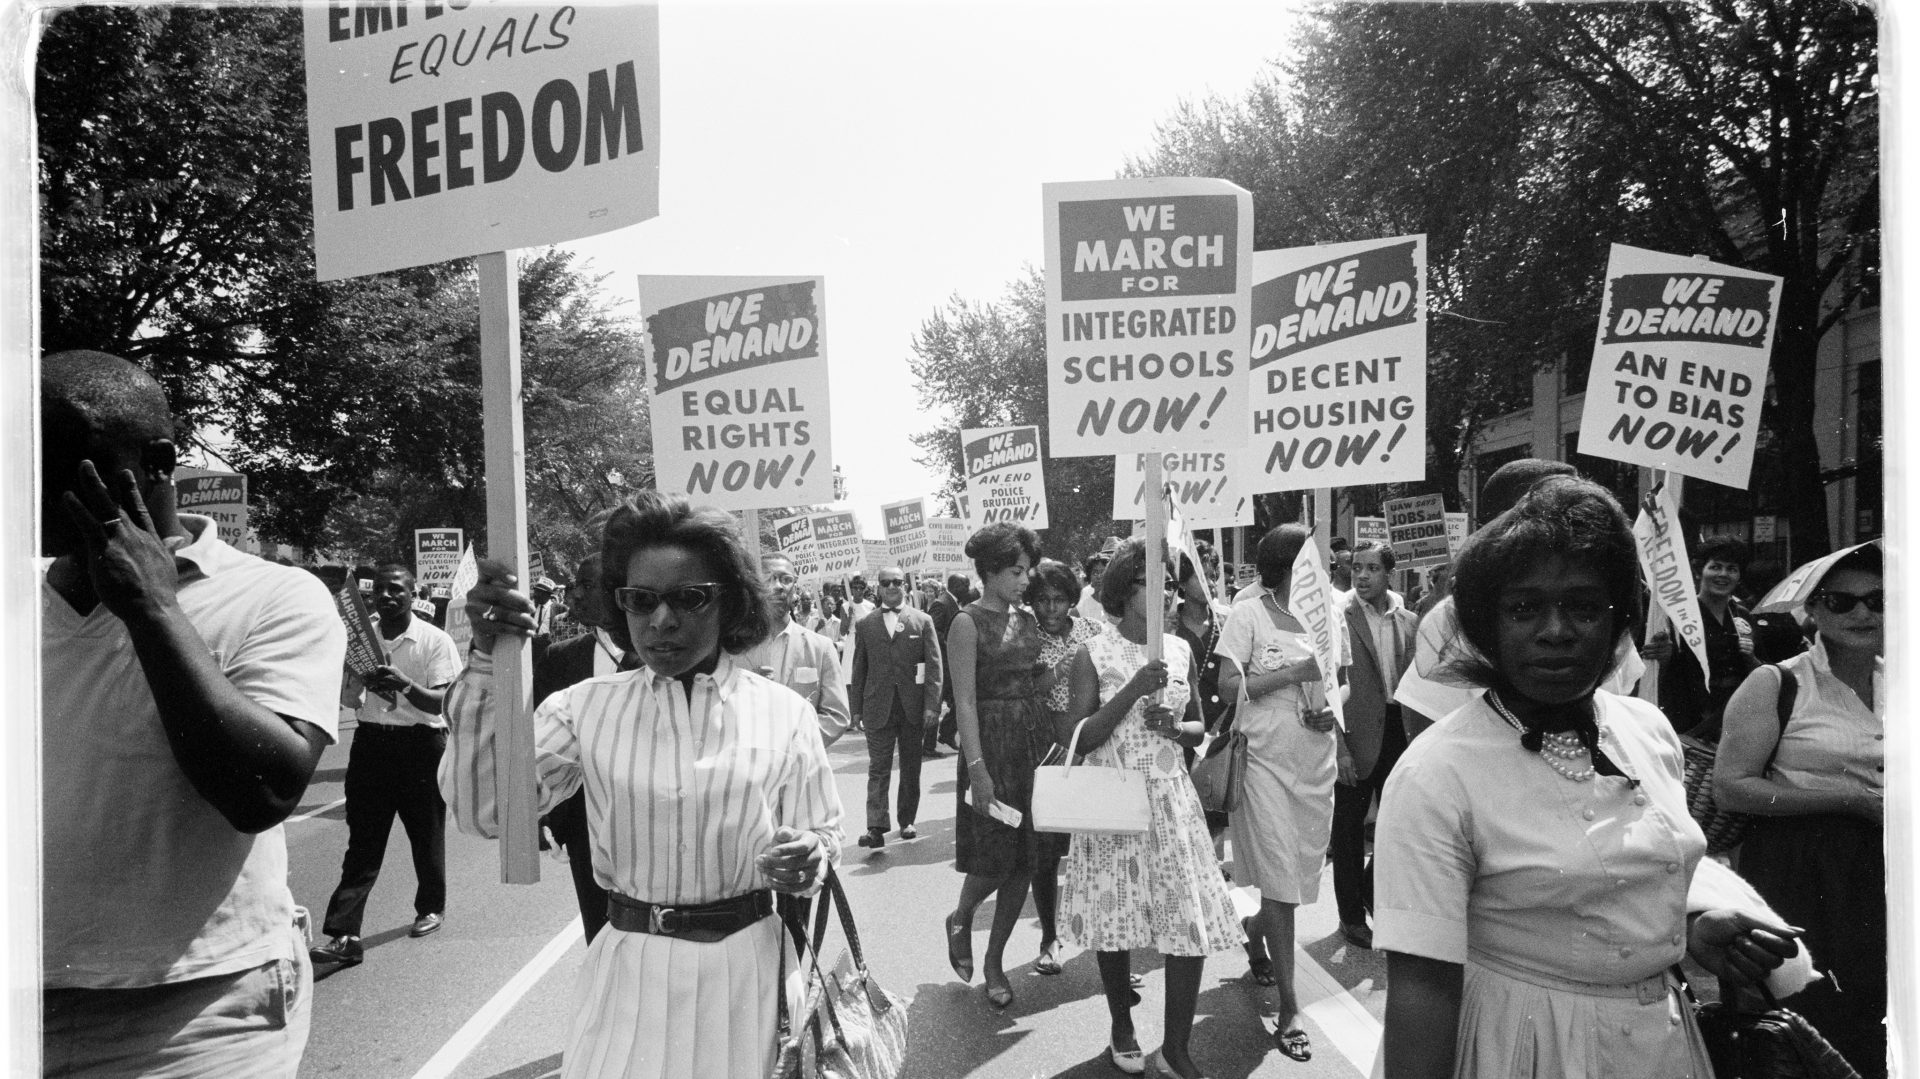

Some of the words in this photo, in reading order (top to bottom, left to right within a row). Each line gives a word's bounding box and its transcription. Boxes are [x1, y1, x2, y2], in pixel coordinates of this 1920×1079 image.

[390, 6, 576, 84] EQUALS
[335, 60, 644, 212] FREEDOM
[1122, 204, 1176, 232] WE
[1074, 234, 1224, 273] MARCH
[1121, 275, 1180, 292] FOR
[1295, 259, 1360, 307] WE
[1662, 277, 1725, 305] WE
[705, 292, 764, 334] WE
[1062, 305, 1237, 342] INTEGRATED
[1251, 281, 1412, 360] DEMAND
[1614, 306, 1764, 338] DEMAND
[665, 317, 813, 381] DEMAND
[1063, 349, 1235, 385] SCHOOLS
[1267, 356, 1402, 394] DECENT
[1615, 350, 1667, 380] AN
[1679, 361, 1752, 397] END
[682, 387, 805, 417] EQUAL
[1076, 386, 1228, 438] NOW!
[1615, 380, 1658, 409] TO
[1668, 390, 1745, 429] BIAS
[1254, 395, 1415, 435] HOUSING
[682, 420, 811, 451] RIGHTS
[988, 432, 1015, 452] WE
[1608, 413, 1742, 464] NOW!
[972, 442, 1034, 474] DEMAND
[1265, 423, 1407, 474] NOW!
[686, 449, 816, 495] NOW!
[1136, 453, 1226, 472] RGHTS
[197, 477, 222, 490] WE
[979, 475, 1000, 485] AN
[1004, 473, 1032, 483] END
[181, 488, 241, 505] DEMAND
[982, 496, 1031, 508] BRUTALITY
[991, 486, 1024, 497] POLICE
[898, 506, 909, 515] WE
[983, 502, 1040, 524] NOW!
[1391, 501, 1413, 511] UAW
[1415, 499, 1436, 507] SAYS
[791, 518, 807, 532] WE
[817, 522, 852, 535] MARCH
[826, 516, 839, 524] WE
[889, 512, 921, 527] MARCH
[1390, 510, 1426, 526] JOBS
[1427, 510, 1441, 521] and
[817, 537, 859, 550] INTEGRATED
[889, 535, 907, 546] FIRST
[908, 530, 926, 541] CLASS
[1391, 524, 1445, 542] FREEDOM
[788, 545, 800, 553] AN
[820, 547, 861, 560] SCHOOLS
[889, 539, 928, 555] CITIZENSHIP
[897, 550, 928, 568] NOW!
[932, 553, 963, 562] REEDOM
[1641, 505, 1688, 607] FREEDOM
[792, 557, 818, 567] BRUTALIT
[825, 555, 860, 572] NOW!
[422, 571, 458, 580] NOW!
[1292, 558, 1330, 658] FREEDOM
[1677, 608, 1688, 620] IN
[340, 587, 360, 626] MARCH
[359, 630, 379, 667] WASHINGT
[1682, 620, 1702, 647] '63
[354, 645, 377, 672] FREEDO
